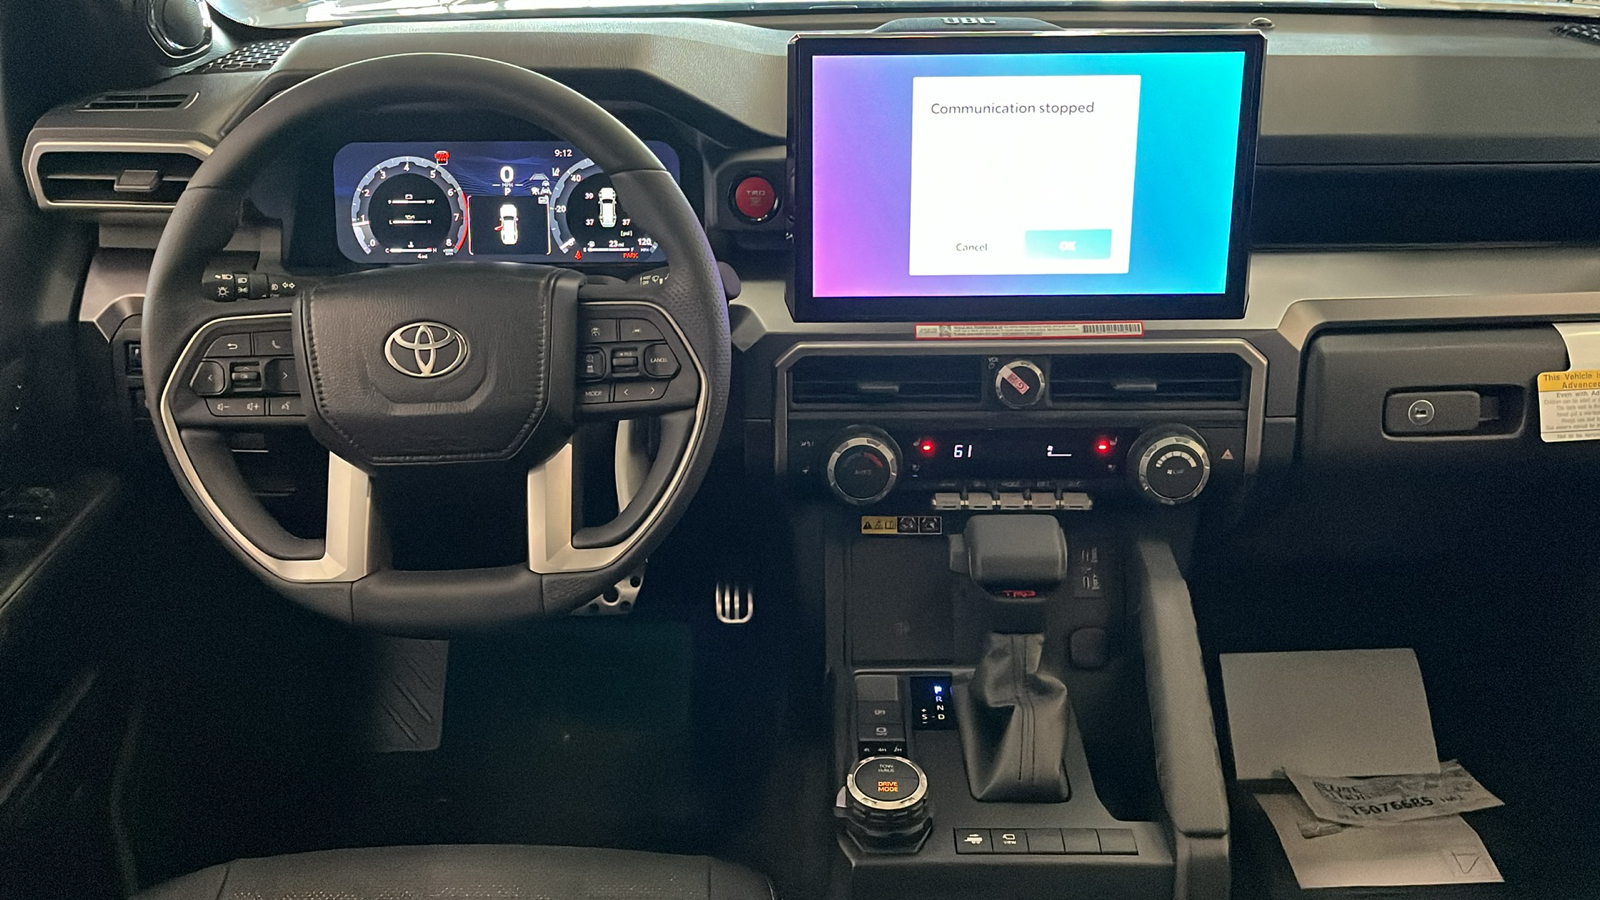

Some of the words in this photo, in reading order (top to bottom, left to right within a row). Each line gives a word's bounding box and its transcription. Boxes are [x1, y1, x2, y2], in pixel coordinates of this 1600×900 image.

[930, 102, 1036, 115] Communication
[1039, 102, 1095, 116] stopped
[554, 149, 573, 157] 9:12
[429, 171, 436, 179] 5
[500, 166, 514, 183] 0
[571, 175, 582, 183] 40
[363, 189, 370, 197] 2
[447, 188, 454, 197] 6
[504, 188, 511, 197] P
[584, 192, 594, 200] 39
[556, 205, 567, 213] 20
[453, 213, 460, 222] 7
[369, 239, 376, 247] 0
[445, 238, 453, 247] 8
[637, 238, 652, 246] 120
[1058, 241, 1077, 251] OK
[955, 243, 988, 252] Cancel
[1564, 372, 1593, 381] Vehicle
[953, 444, 973, 458] 61
[933, 685, 943, 695] P
